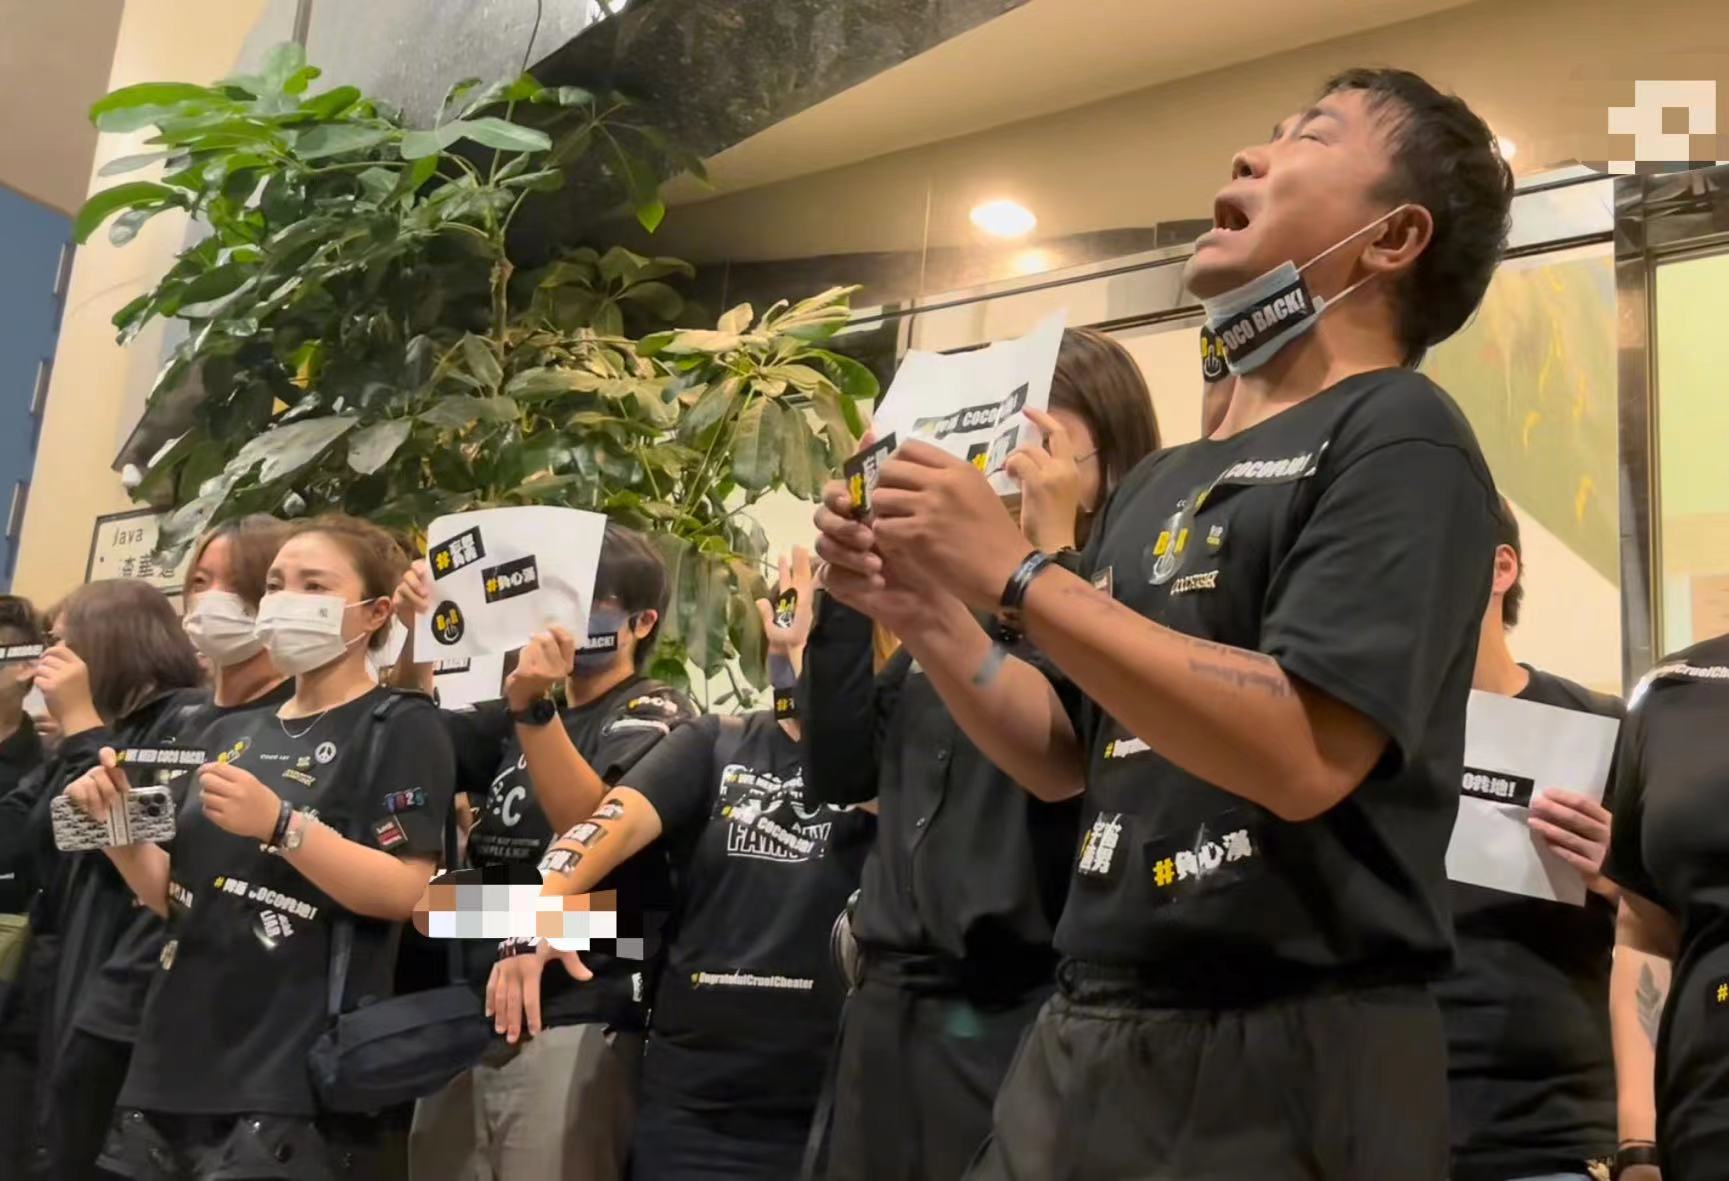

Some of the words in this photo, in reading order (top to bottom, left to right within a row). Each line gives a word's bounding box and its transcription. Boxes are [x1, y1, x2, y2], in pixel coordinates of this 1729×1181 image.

[1223, 323, 1255, 351] OCO
[1252, 287, 1307, 333] BACK!
[112, 526, 144, 547] Java
